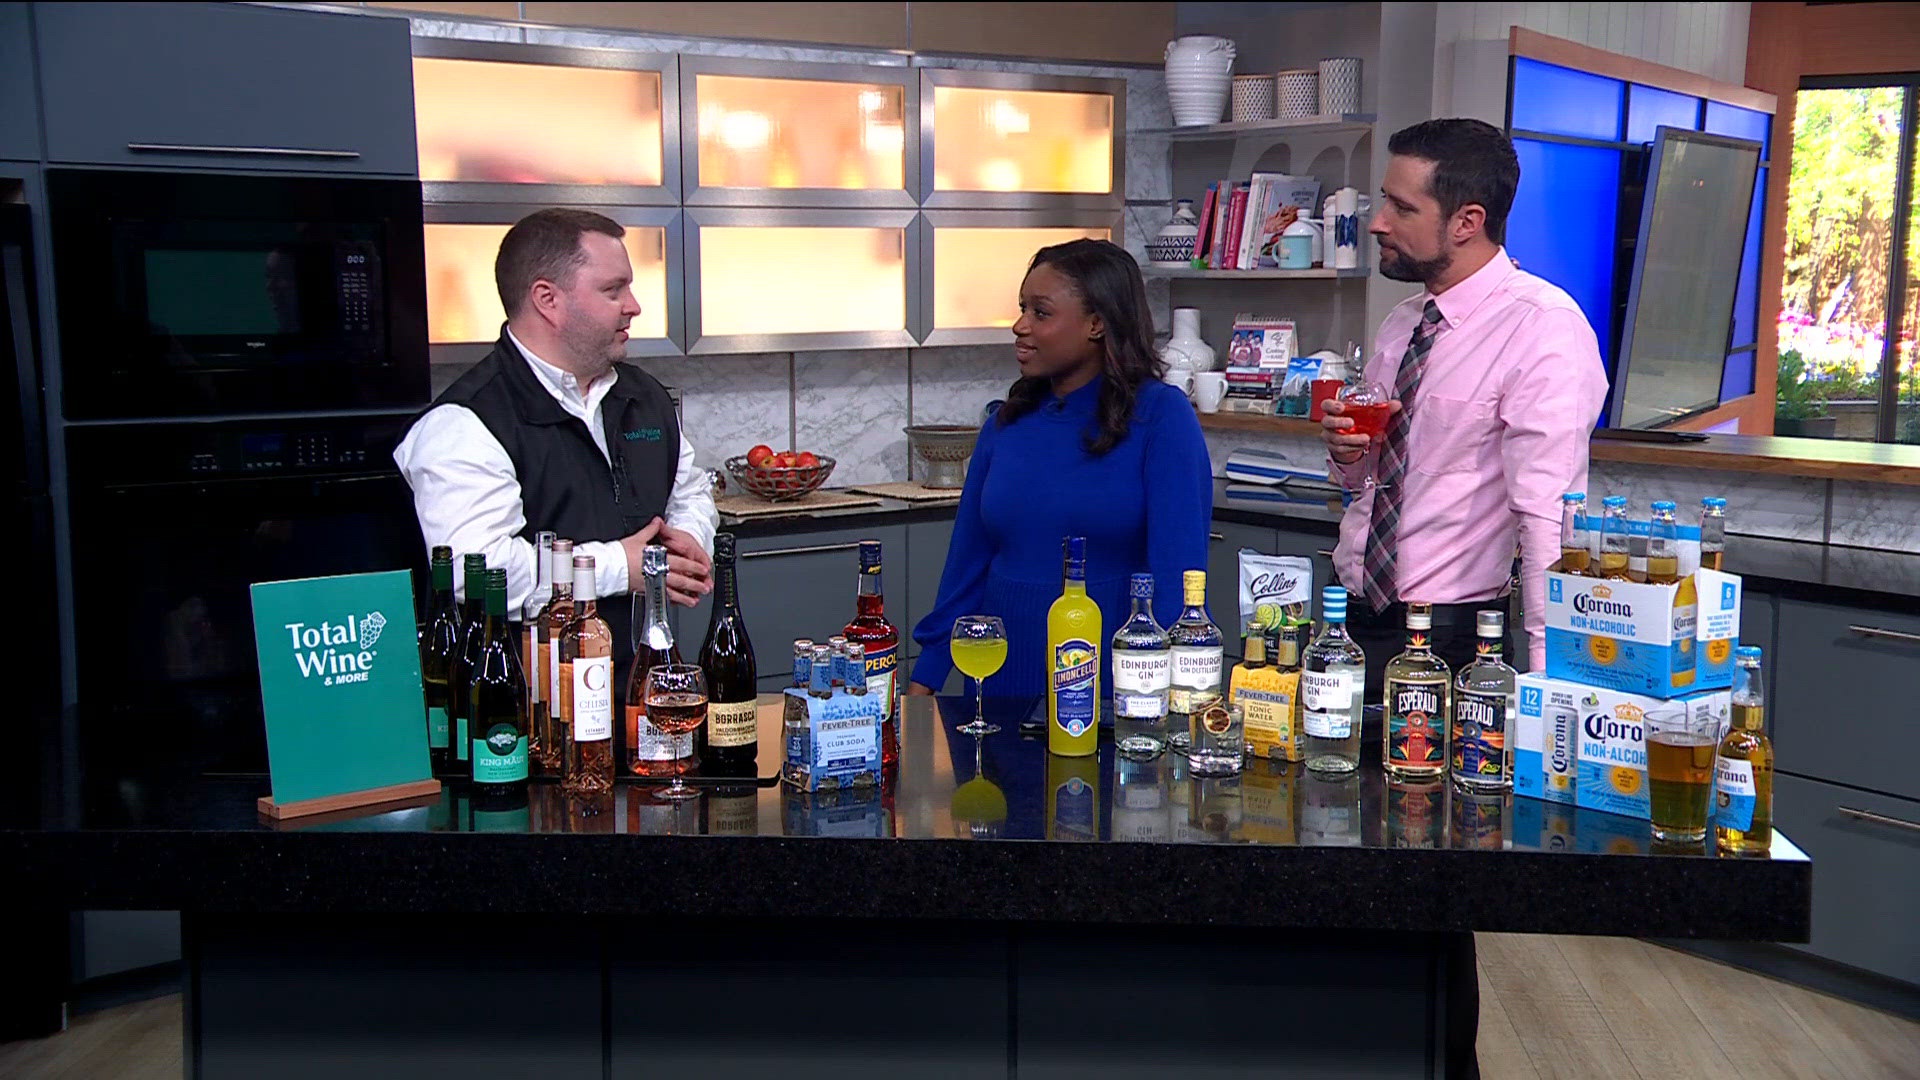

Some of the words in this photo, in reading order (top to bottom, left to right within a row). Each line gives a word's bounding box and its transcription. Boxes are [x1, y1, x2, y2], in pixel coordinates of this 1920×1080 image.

[1250, 572, 1299, 598] Collins
[1552, 581, 1559, 592] 6
[1725, 587, 1732, 598] 6
[1573, 591, 1632, 618] Corona
[285, 614, 358, 650] Total
[1570, 615, 1636, 637] NON-ALCOHOLIC
[295, 648, 373, 678] Wine
[865, 653, 897, 672] PEROL
[1121, 659, 1168, 670] EDINBURGH
[1179, 656, 1221, 666] EDINBURGH
[324, 676, 333, 686] &
[335, 671, 369, 685] MORE
[583, 663, 606, 691] C
[1054, 658, 1097, 688] LIMONCELLO
[1138, 671, 1154, 680] GIN
[1305, 675, 1340, 688] NBURGH
[1240, 690, 1285, 703] FEVER-TREE
[1307, 686, 1320, 696] GIN
[1525, 689, 1538, 705] 12
[1551, 697, 1573, 706] OPENING
[715, 709, 755, 724] BORRASCA
[1248, 712, 1273, 721] WATER
[1249, 705, 1272, 714] TONIC
[821, 719, 872, 731] FEVER-TREE
[1584, 712, 1643, 745] Coro
[846, 738, 866, 746] SODA
[1551, 714, 1569, 773] Corona
[1583, 741, 1647, 766] NON-ALCOH
[480, 757, 502, 767] KING
[1719, 769, 1748, 784] rona
